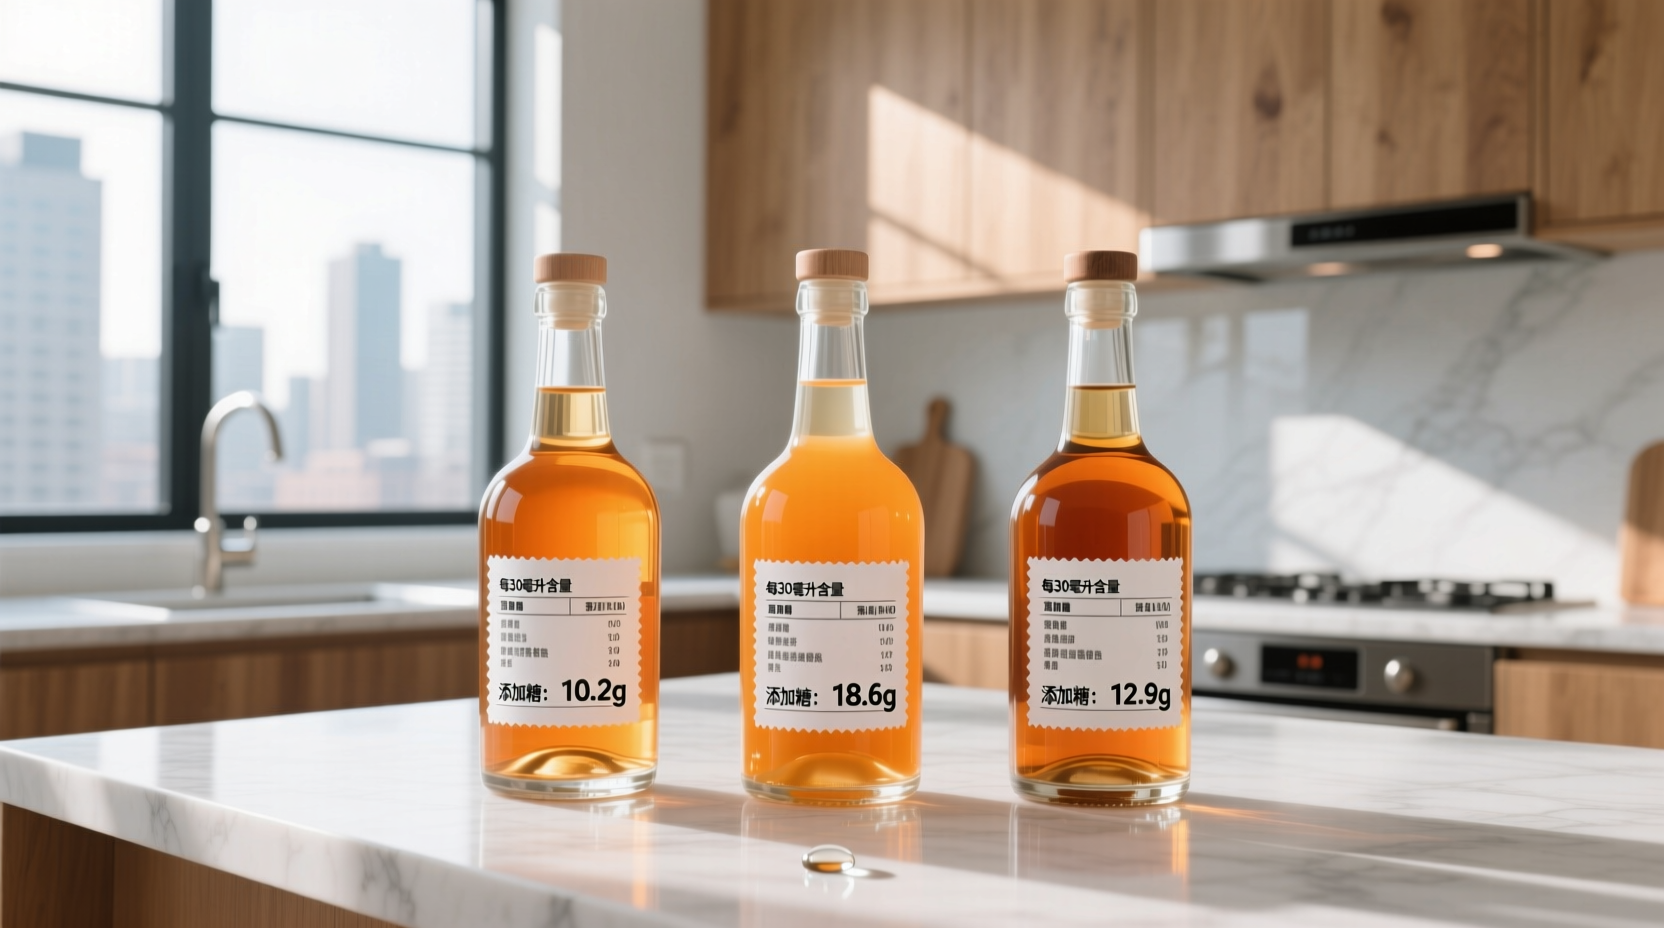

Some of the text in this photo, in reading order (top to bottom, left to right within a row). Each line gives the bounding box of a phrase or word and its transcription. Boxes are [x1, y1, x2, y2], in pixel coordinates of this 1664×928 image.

[561, 678, 627, 707] 10.2g
[832, 682, 896, 712] 18.6g
[1111, 682, 1171, 711] 12.9g
